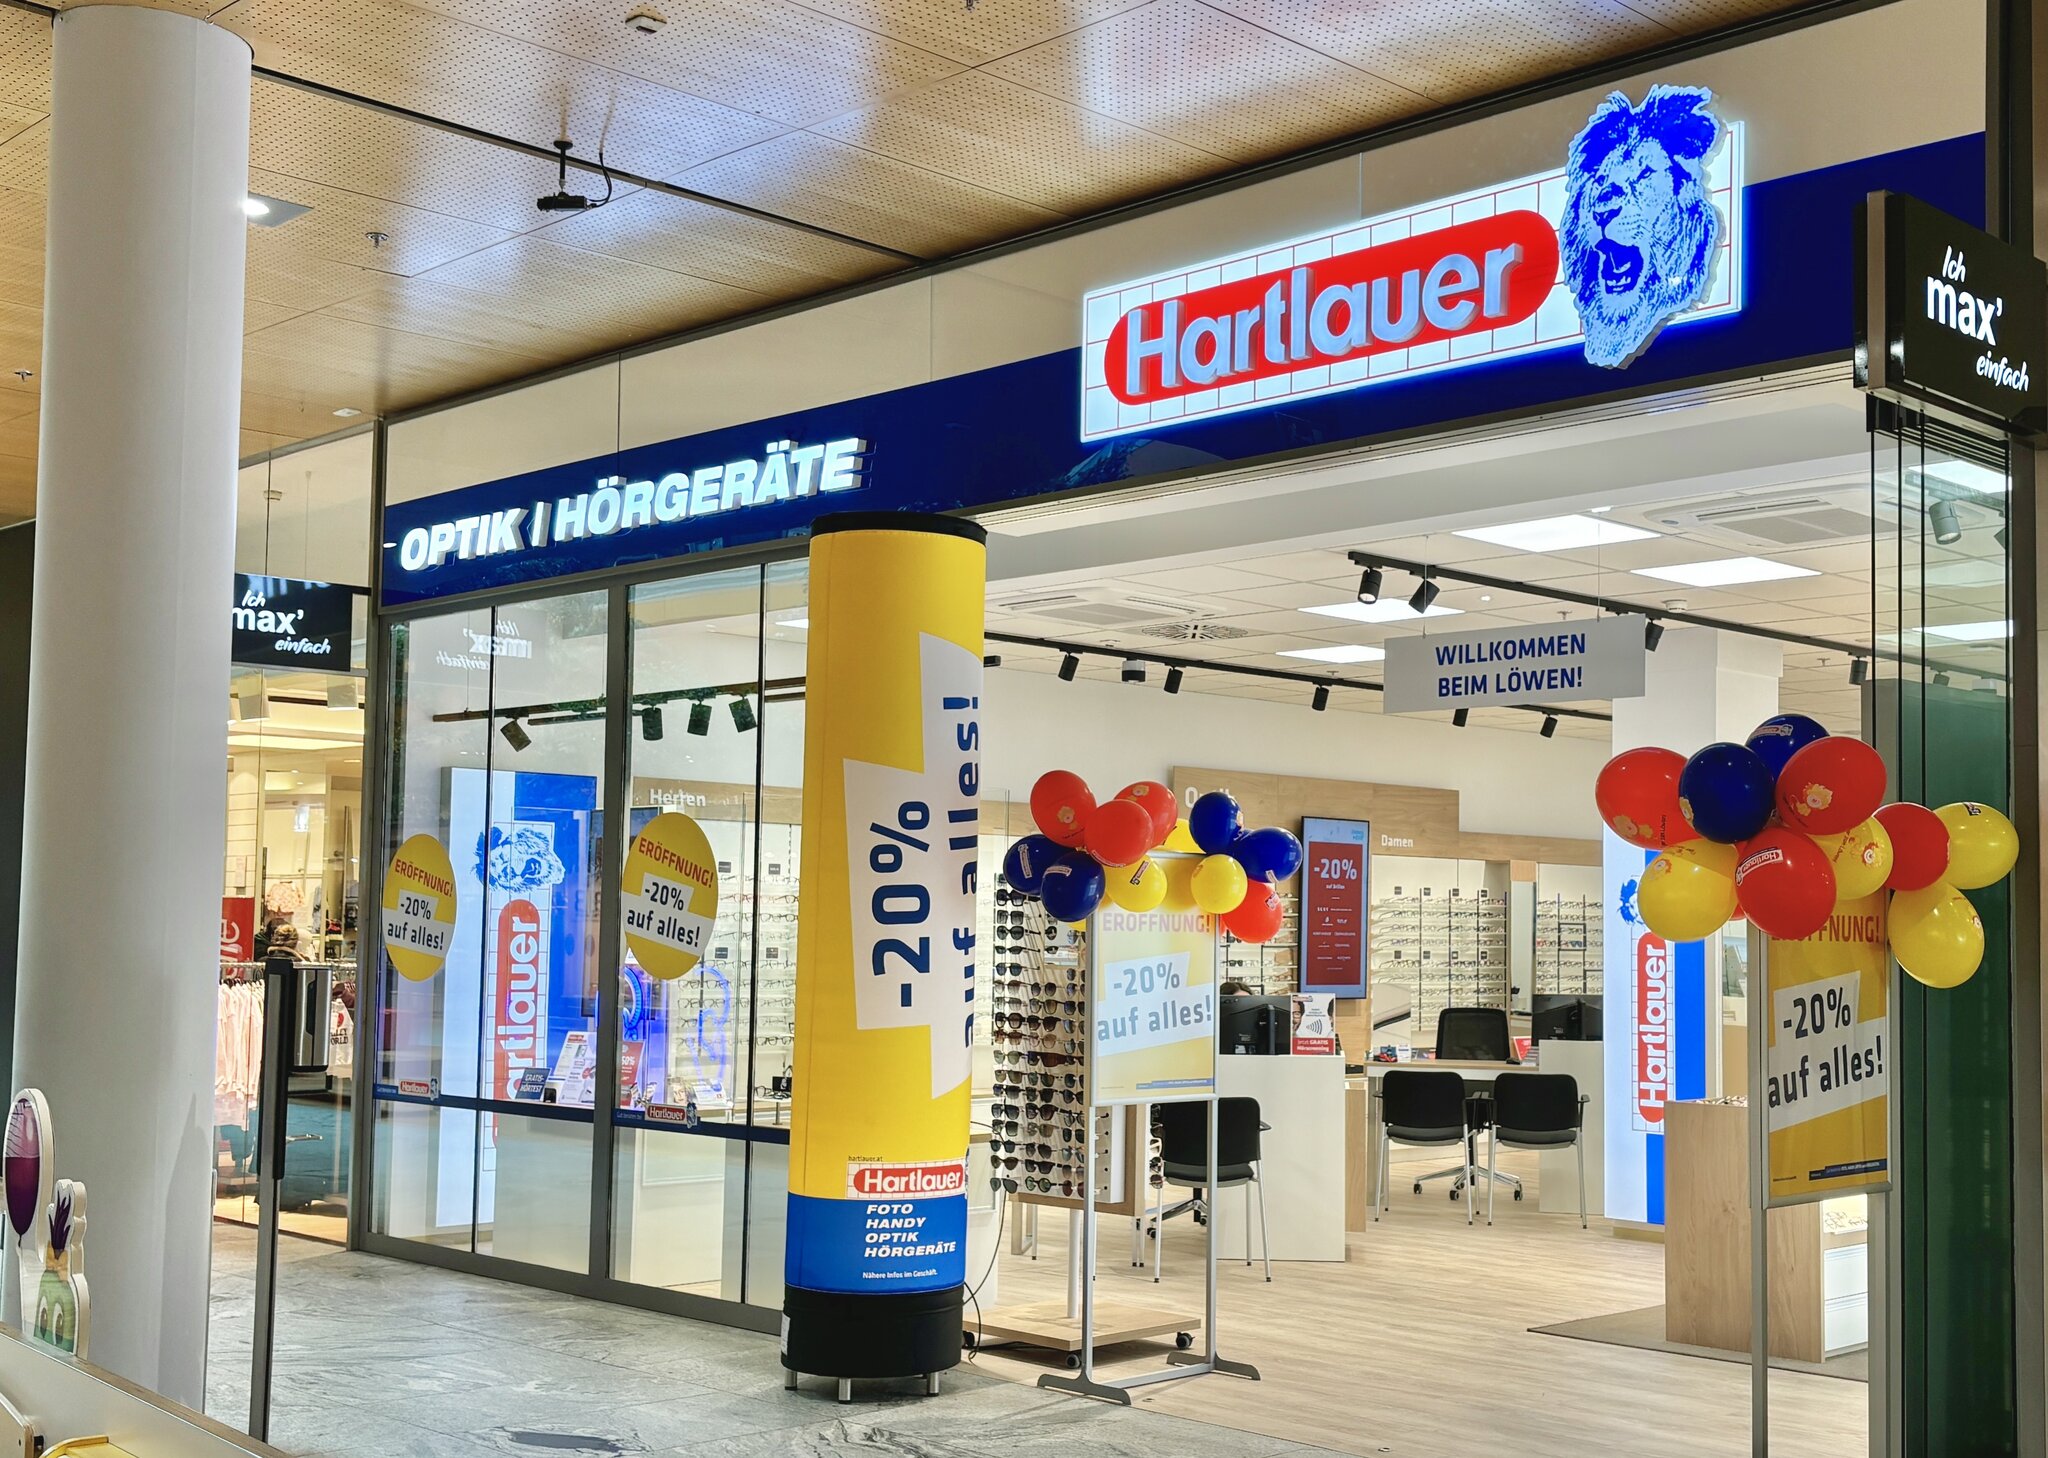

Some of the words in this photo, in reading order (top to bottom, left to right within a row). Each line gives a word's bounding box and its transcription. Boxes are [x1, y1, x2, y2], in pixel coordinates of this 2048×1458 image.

[1942, 245, 1966, 282] Ich
[1125, 243, 1522, 396] Hartlauer
[1976, 350, 2029, 392] einfach
[400, 508, 524, 571] OPTIK
[555, 437, 865, 544] HÖRGERÄTE
[242, 590, 266, 607] Ich
[275, 636, 331, 654] einfach
[1435, 633, 1586, 666] WILLKOMMEN
[1438, 674, 1488, 698] BEIM
[1495, 666, 1583, 693] LÖWEN!
[1381, 834, 1414, 848] Damen
[395, 859, 454, 897] ERÖFFNUNG!
[638, 837, 714, 888] ERÖFFNUNG!
[1314, 858, 1357, 880] -20%
[400, 897, 431, 920] -20%
[645, 881, 684, 911] -20%
[869, 801, 931, 1008] -20%
[387, 922, 408, 940] auf
[411, 925, 444, 950] alles!
[627, 909, 654, 932] auf
[657, 916, 700, 948] alles!
[1113, 962, 1180, 997] -20%
[498, 915, 538, 1100] artlauer
[1097, 1006, 1139, 1041] auf
[1149, 995, 1212, 1032] alles!
[1783, 987, 1851, 1039] -20%
[1639, 944, 1667, 1108] Hartlauer
[1768, 1055, 1809, 1108] auf
[1819, 1035, 1883, 1092] alles!
[649, 1107, 684, 1121] Hartlauer
[864, 1169, 961, 1192] Hartlauer
[866, 1204, 914, 1214] FOTO
[866, 1217, 926, 1229] HANDY
[864, 1241, 956, 1257] HÖRGERÄTE
[865, 1232, 919, 1243] OPTIK
[862, 1271, 886, 1279] Nähere
[887, 1271, 903, 1279] Infos
